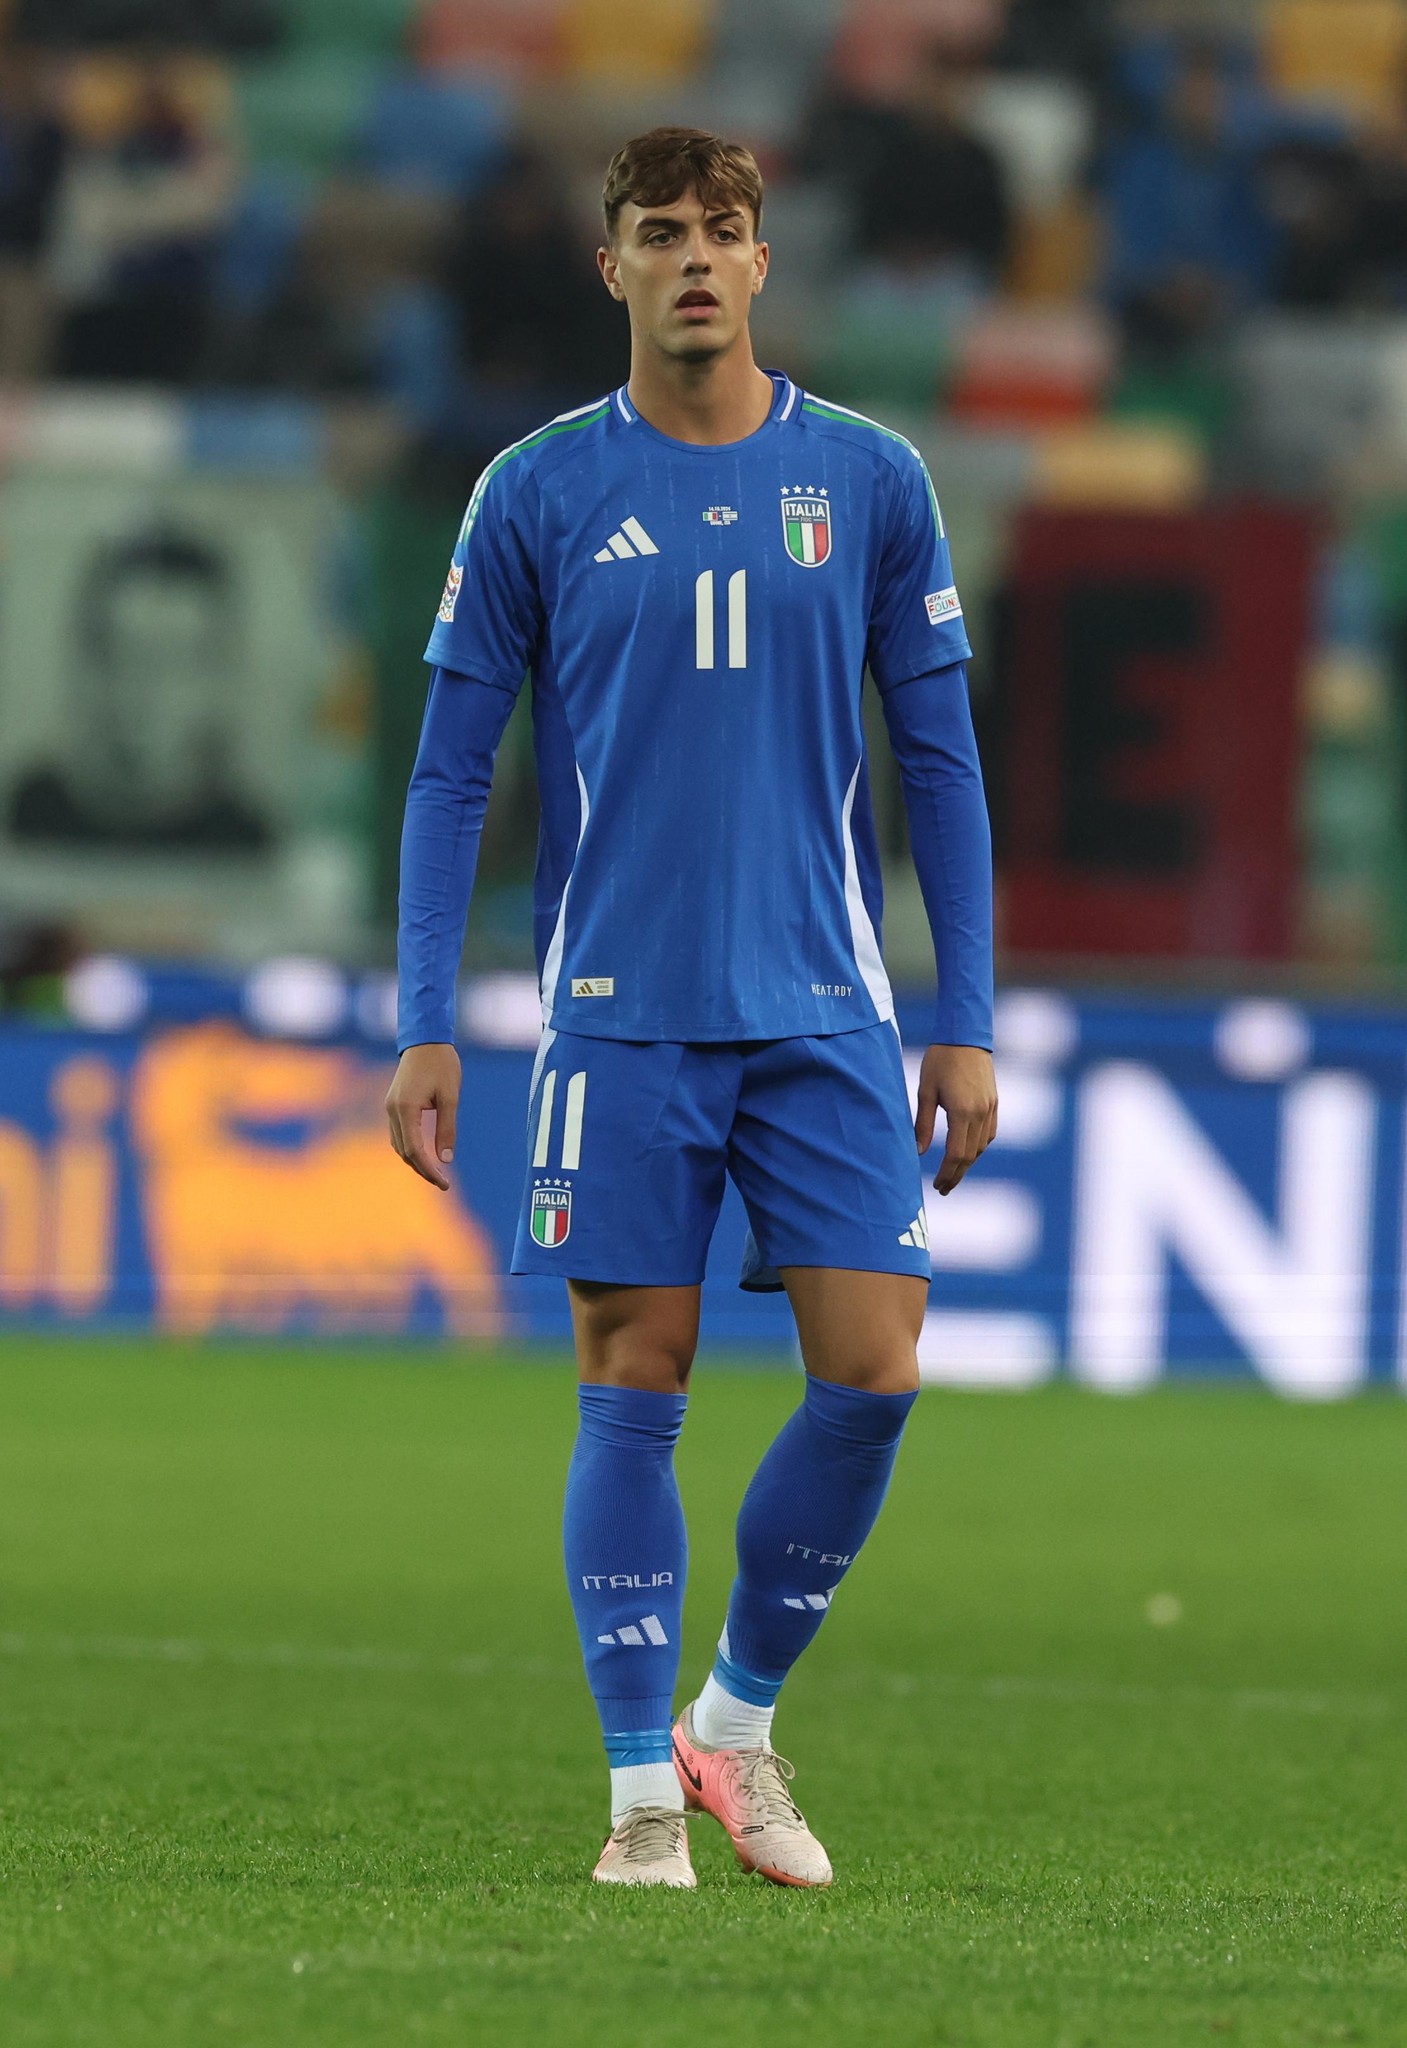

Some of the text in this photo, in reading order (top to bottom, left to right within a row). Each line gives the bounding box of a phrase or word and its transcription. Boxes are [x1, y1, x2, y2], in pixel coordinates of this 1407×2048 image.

[784, 503, 826, 517] ITALIA
[928, 597, 958, 613] FOUN
[695, 569, 747, 669] 11
[810, 983, 852, 997] HEAT.RDY
[532, 1069, 587, 1170] 11
[535, 1193, 568, 1206] ITALIA
[900, 1050, 1407, 1398] EN
[786, 1543, 860, 1567] ITAL
[582, 1571, 673, 1590] ITALIA
